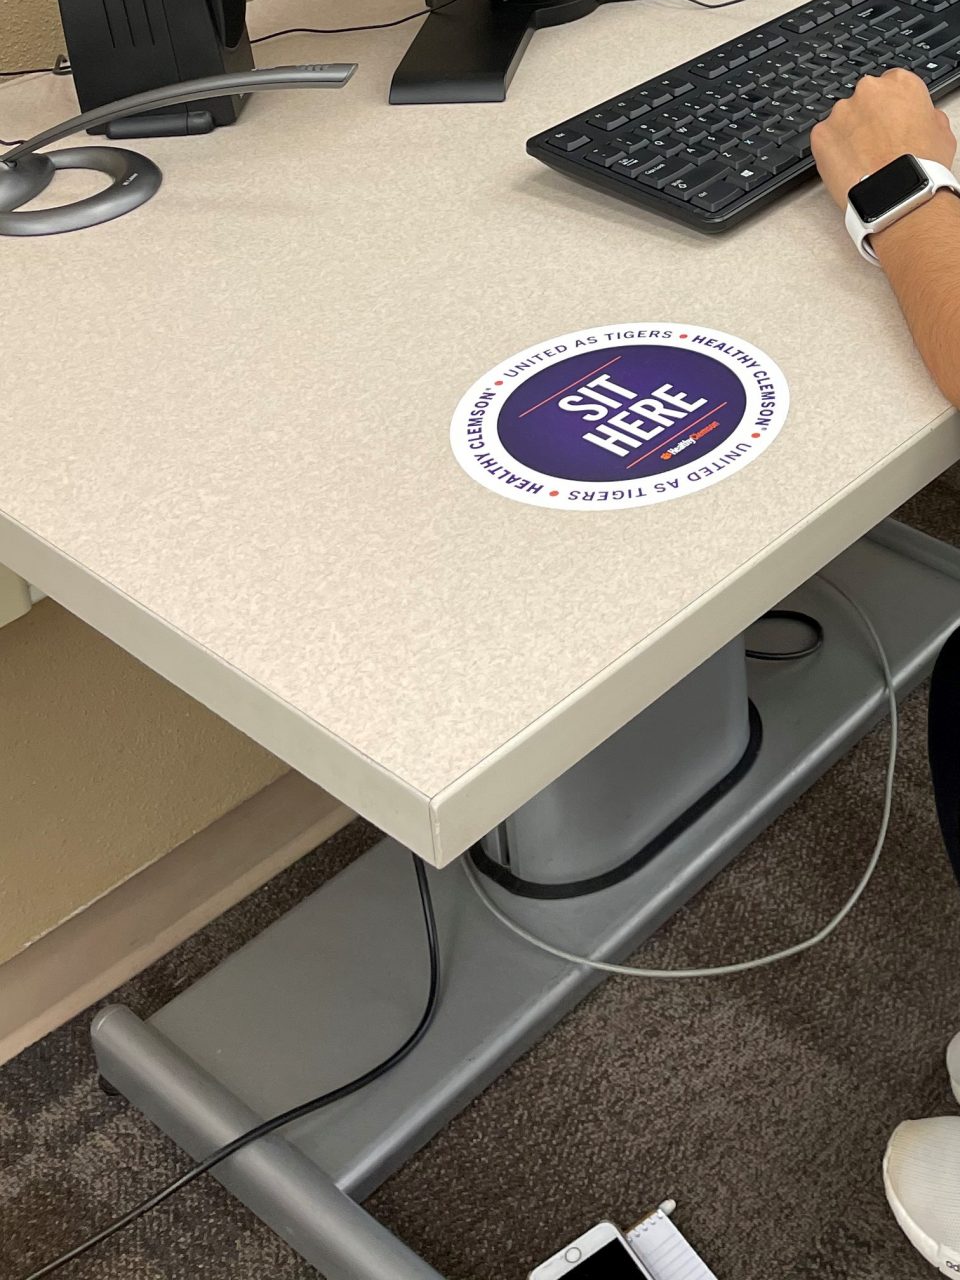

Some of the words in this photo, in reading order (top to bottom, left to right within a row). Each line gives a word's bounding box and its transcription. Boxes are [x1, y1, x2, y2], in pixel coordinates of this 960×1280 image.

[504, 344, 568, 379] UNITED
[575, 335, 598, 349] AS
[604, 329, 673, 342] TIGERS
[691, 335, 761, 369] HEALTHY
[557, 373, 638, 422] SIT
[582, 383, 708, 458] HERE
[474, 453, 544, 495] HEALTHY
[687, 441, 752, 483] UNITED
[567, 488, 647, 502] TIGERS
[654, 478, 680, 493] AS
